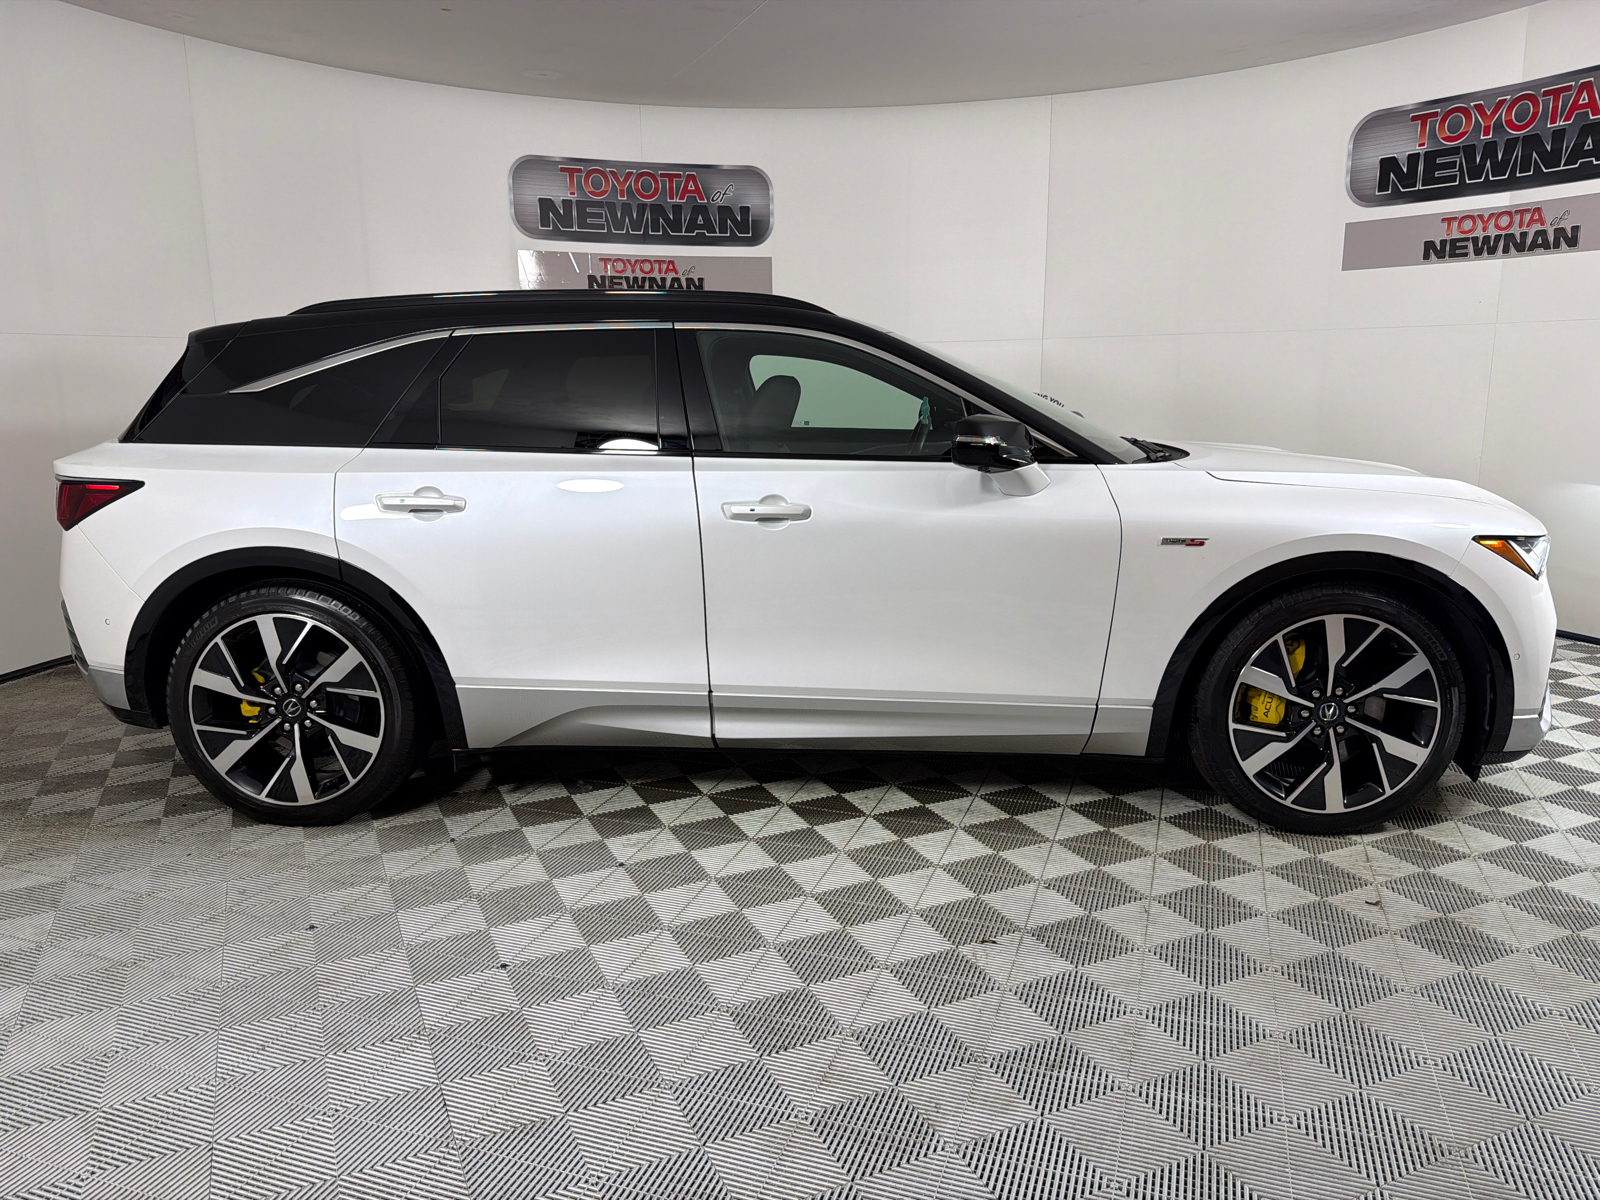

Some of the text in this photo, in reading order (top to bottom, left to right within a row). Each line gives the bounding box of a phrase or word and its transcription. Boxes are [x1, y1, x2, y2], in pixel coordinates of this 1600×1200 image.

[1410, 78, 1600, 149] TOYOTA
[1376, 120, 1600, 195] NEWNA
[558, 164, 734, 203] TOYOTA of
[538, 197, 752, 237] NEWNAN
[1440, 206, 1570, 236] TOYOTA of
[1422, 225, 1581, 262] NEWNAN
[587, 275, 705, 290] NEWNAN
[598, 257, 697, 277] TOYOTA of
[1262, 693, 1275, 718] ACU
